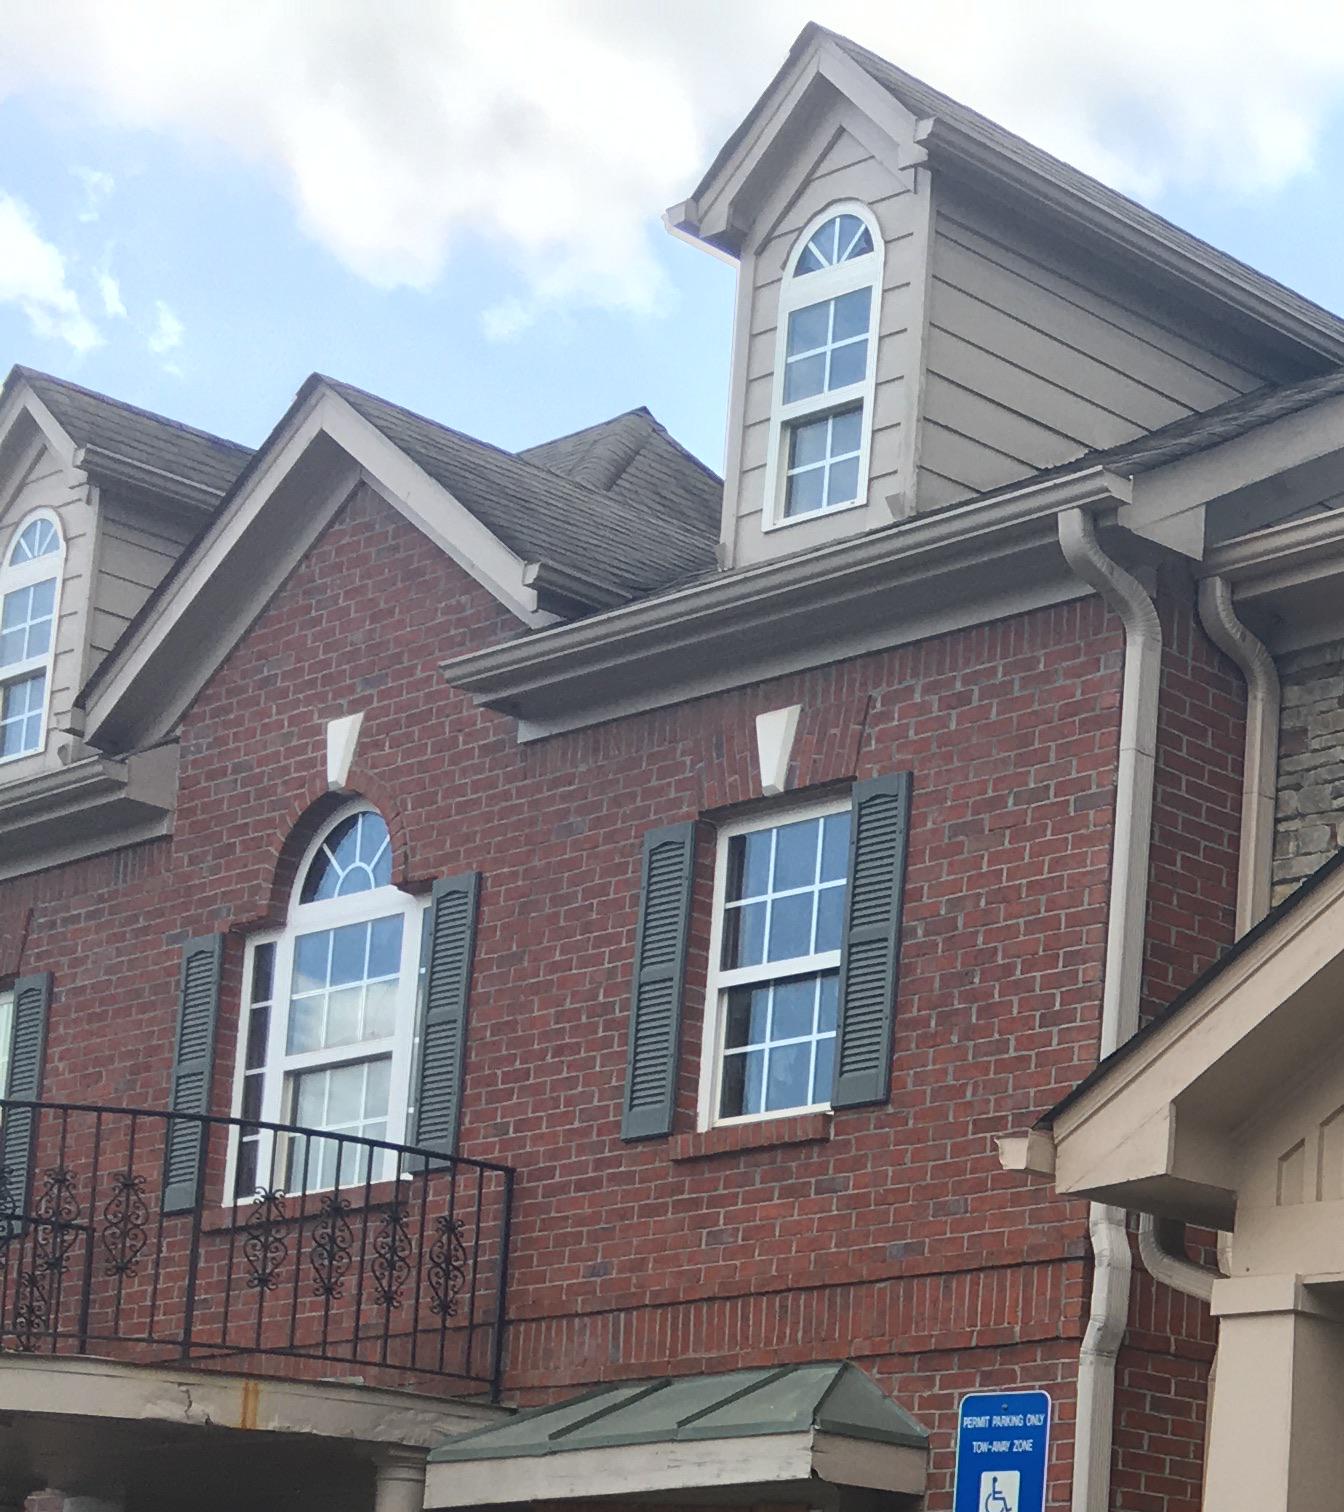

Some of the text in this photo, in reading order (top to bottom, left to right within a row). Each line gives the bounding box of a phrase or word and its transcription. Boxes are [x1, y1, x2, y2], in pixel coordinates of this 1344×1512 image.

[963, 1413, 1046, 1428] PERMIT PARKING ONLY
[972, 1439, 1034, 1453] TOW-AWAY ZONE
